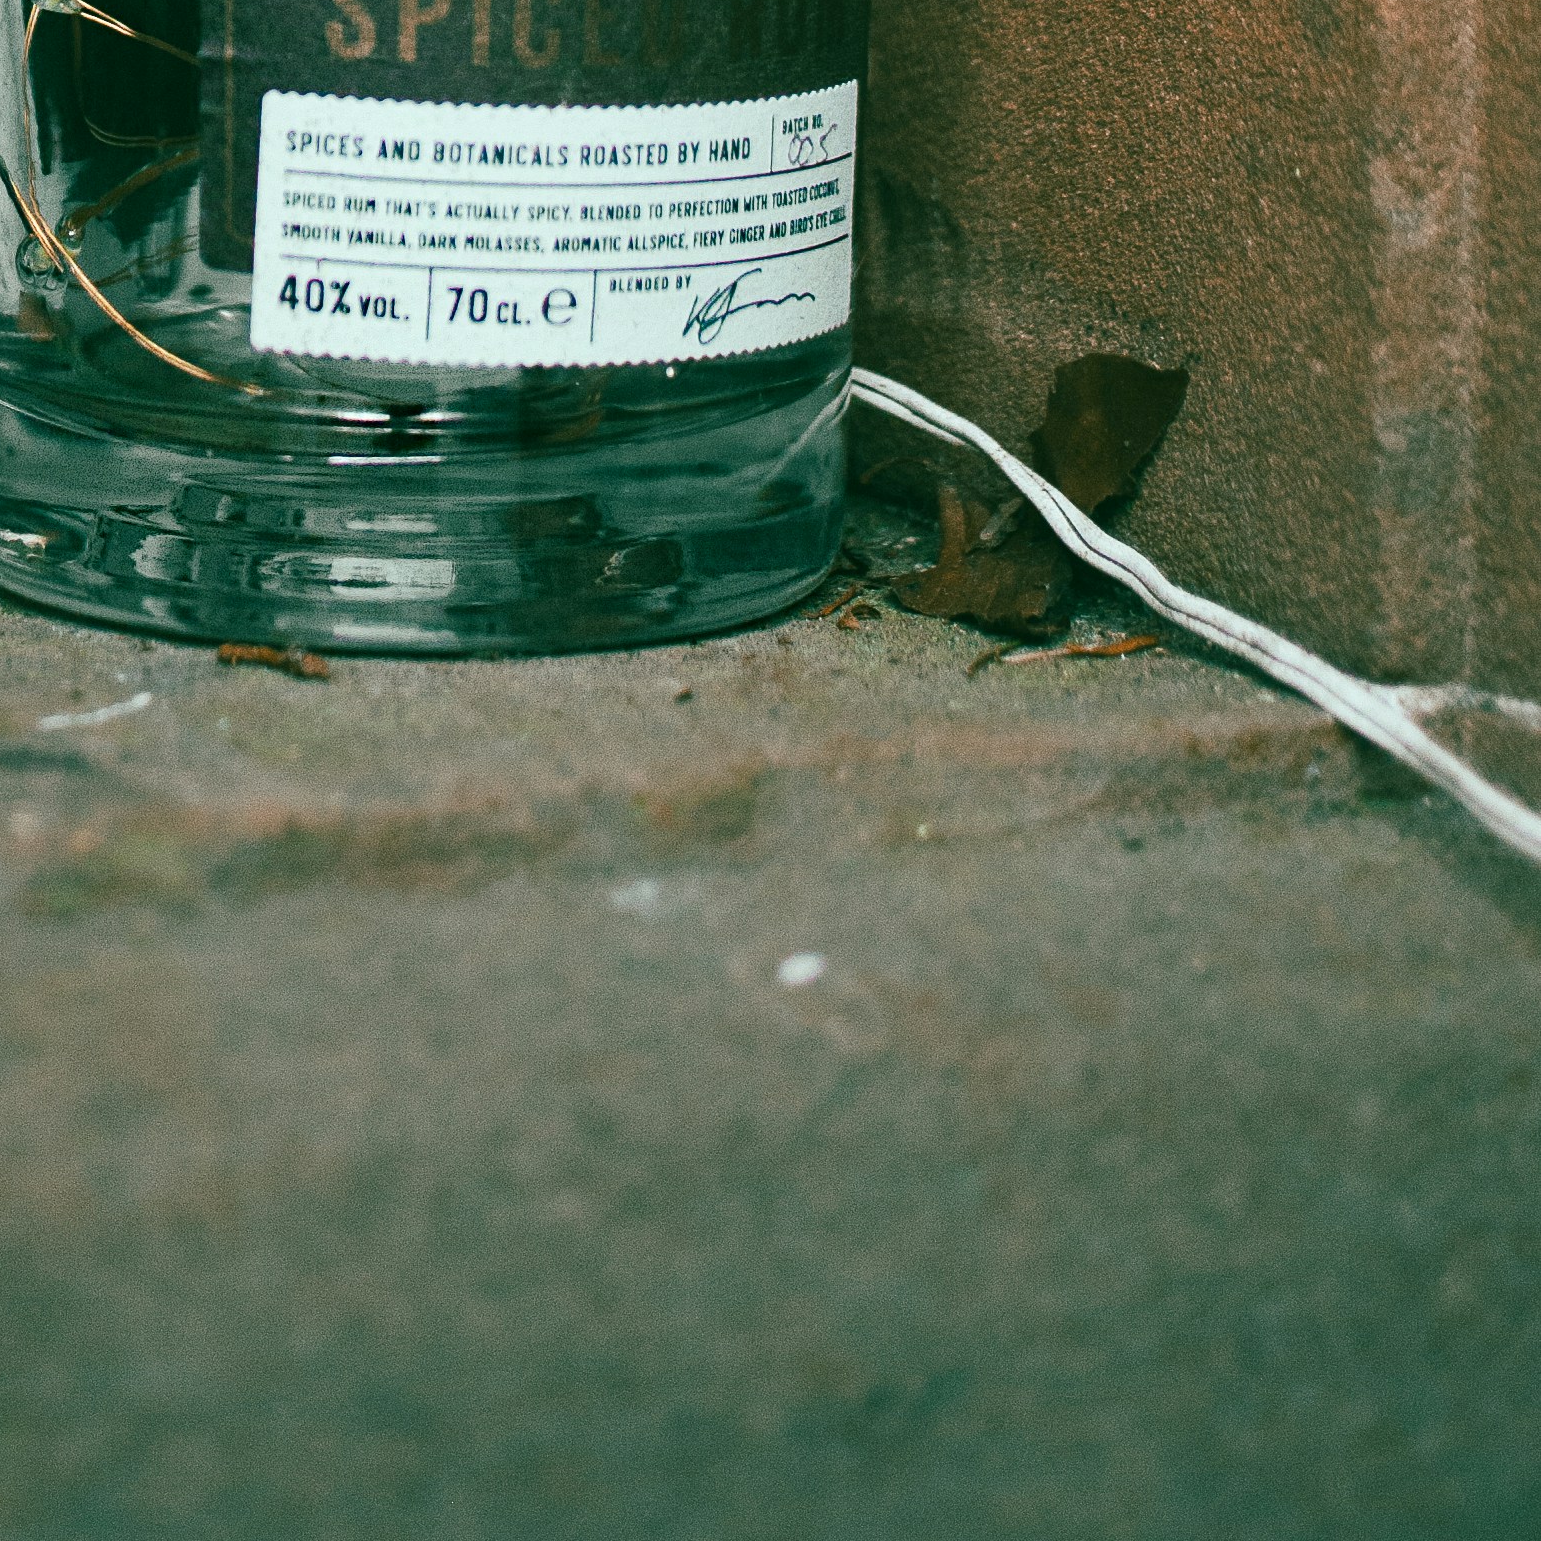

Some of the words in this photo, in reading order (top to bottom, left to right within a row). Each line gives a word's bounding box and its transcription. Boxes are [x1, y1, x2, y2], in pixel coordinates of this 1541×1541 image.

[781, 115, 810, 136] BATCH
[285, 129, 365, 158] SPICES
[376, 138, 421, 162] AND
[432, 140, 569, 168] BOTANICALS
[579, 143, 669, 167] ROASTED
[677, 140, 701, 164] BY
[709, 136, 752, 162] HAND
[282, 189, 337, 211] SPICED
[343, 196, 377, 214] RUM
[385, 199, 438, 218] THAT'S
[444, 202, 519, 222] ACTUALLY
[579, 203, 641, 222] BLENDED
[648, 202, 663, 220] TO
[668, 196, 740, 219] PERFECTION
[743, 192, 768, 212] WITH
[772, 186, 808, 209] TOASTED
[280, 220, 341, 243] SMOOTH
[346, 227, 412, 250] VANILLA,
[418, 231, 457, 249] DARK
[463, 233, 545, 254] MOLASSES,
[551, 235, 621, 254] AROMATIC
[626, 231, 689, 253] ALLSPICE,
[692, 227, 725, 249] FIERY
[728, 223, 765, 245] GINGER
[768, 221, 787, 239] AND
[789, 215, 814, 237] BIRD'S
[815, 210, 829, 230] EYE
[278, 273, 352, 317] 40%
[358, 292, 411, 322] VOL.
[608, 275, 669, 293] BLENDED
[675, 273, 693, 291] BY
[445, 286, 489, 324] 70
[495, 300, 532, 325] CL.
